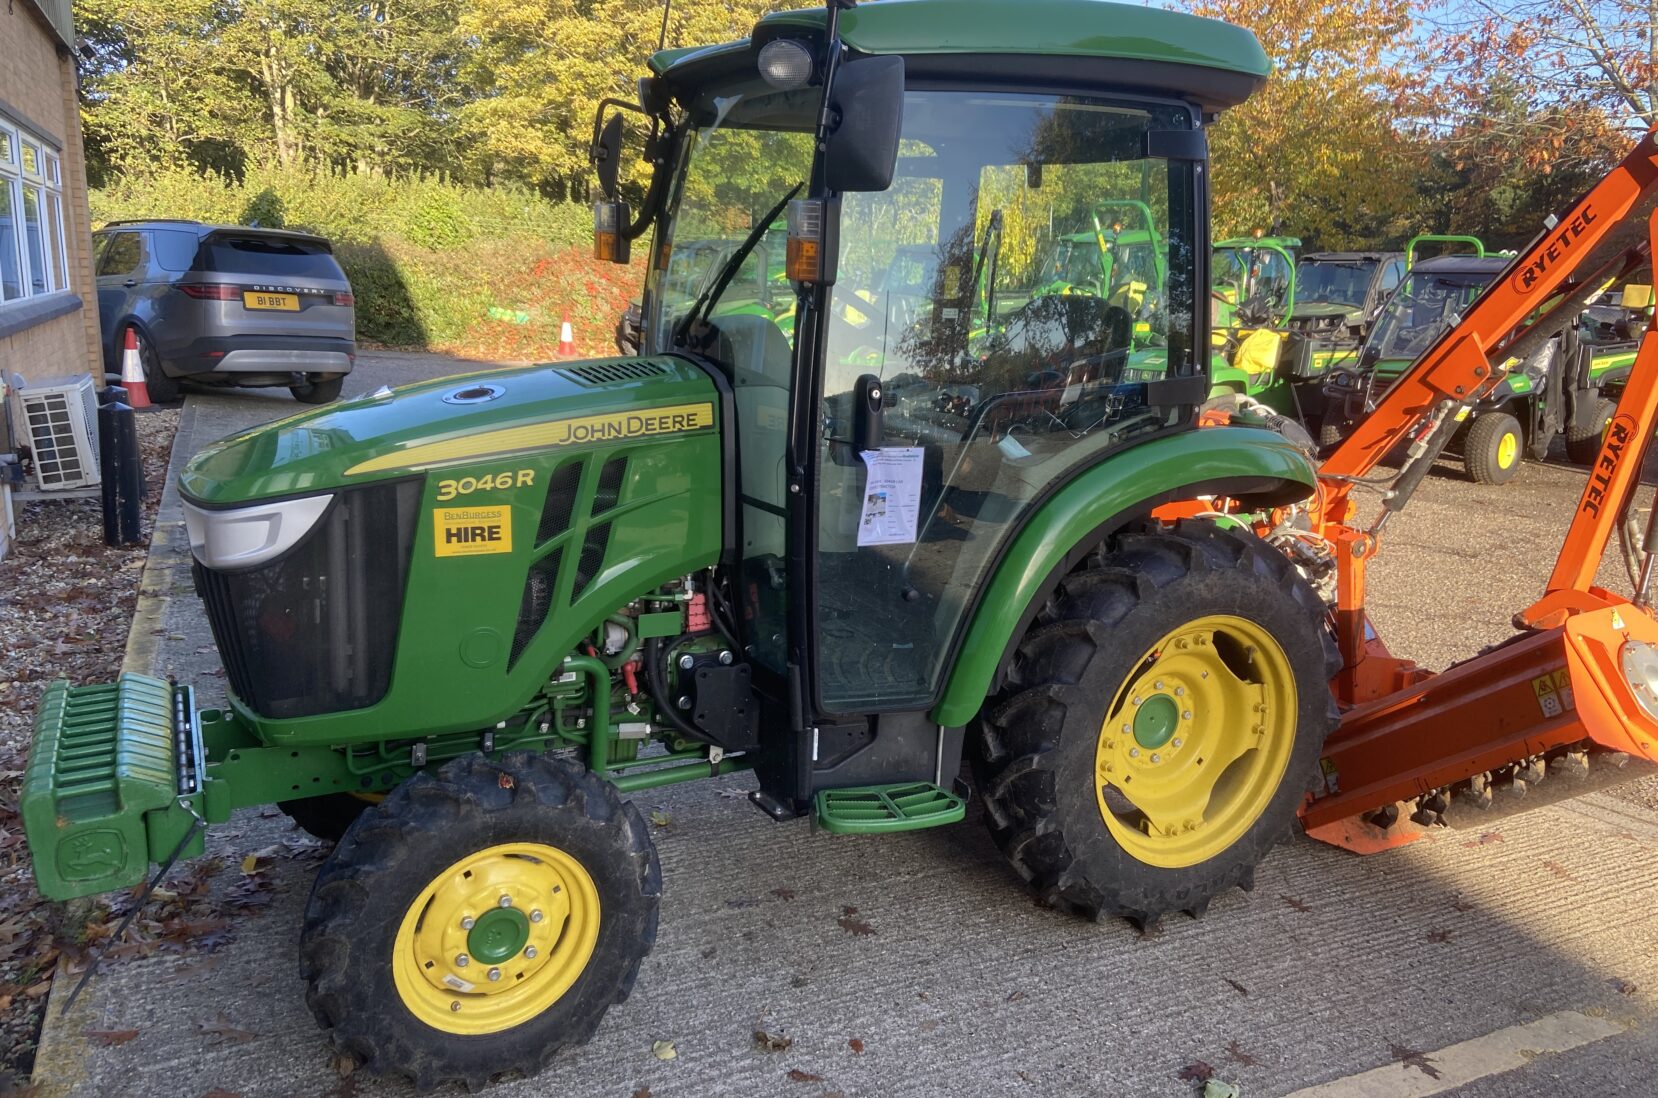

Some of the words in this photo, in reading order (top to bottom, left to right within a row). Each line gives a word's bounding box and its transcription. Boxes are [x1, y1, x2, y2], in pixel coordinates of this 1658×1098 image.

[1520, 203, 1598, 289] RYETEC
[253, 285, 325, 294] DISCOVERY
[559, 420, 622, 443] JOHN
[627, 412, 698, 435] DEERE
[1582, 422, 1630, 519] RYETEC
[445, 525, 502, 544] HIRE
